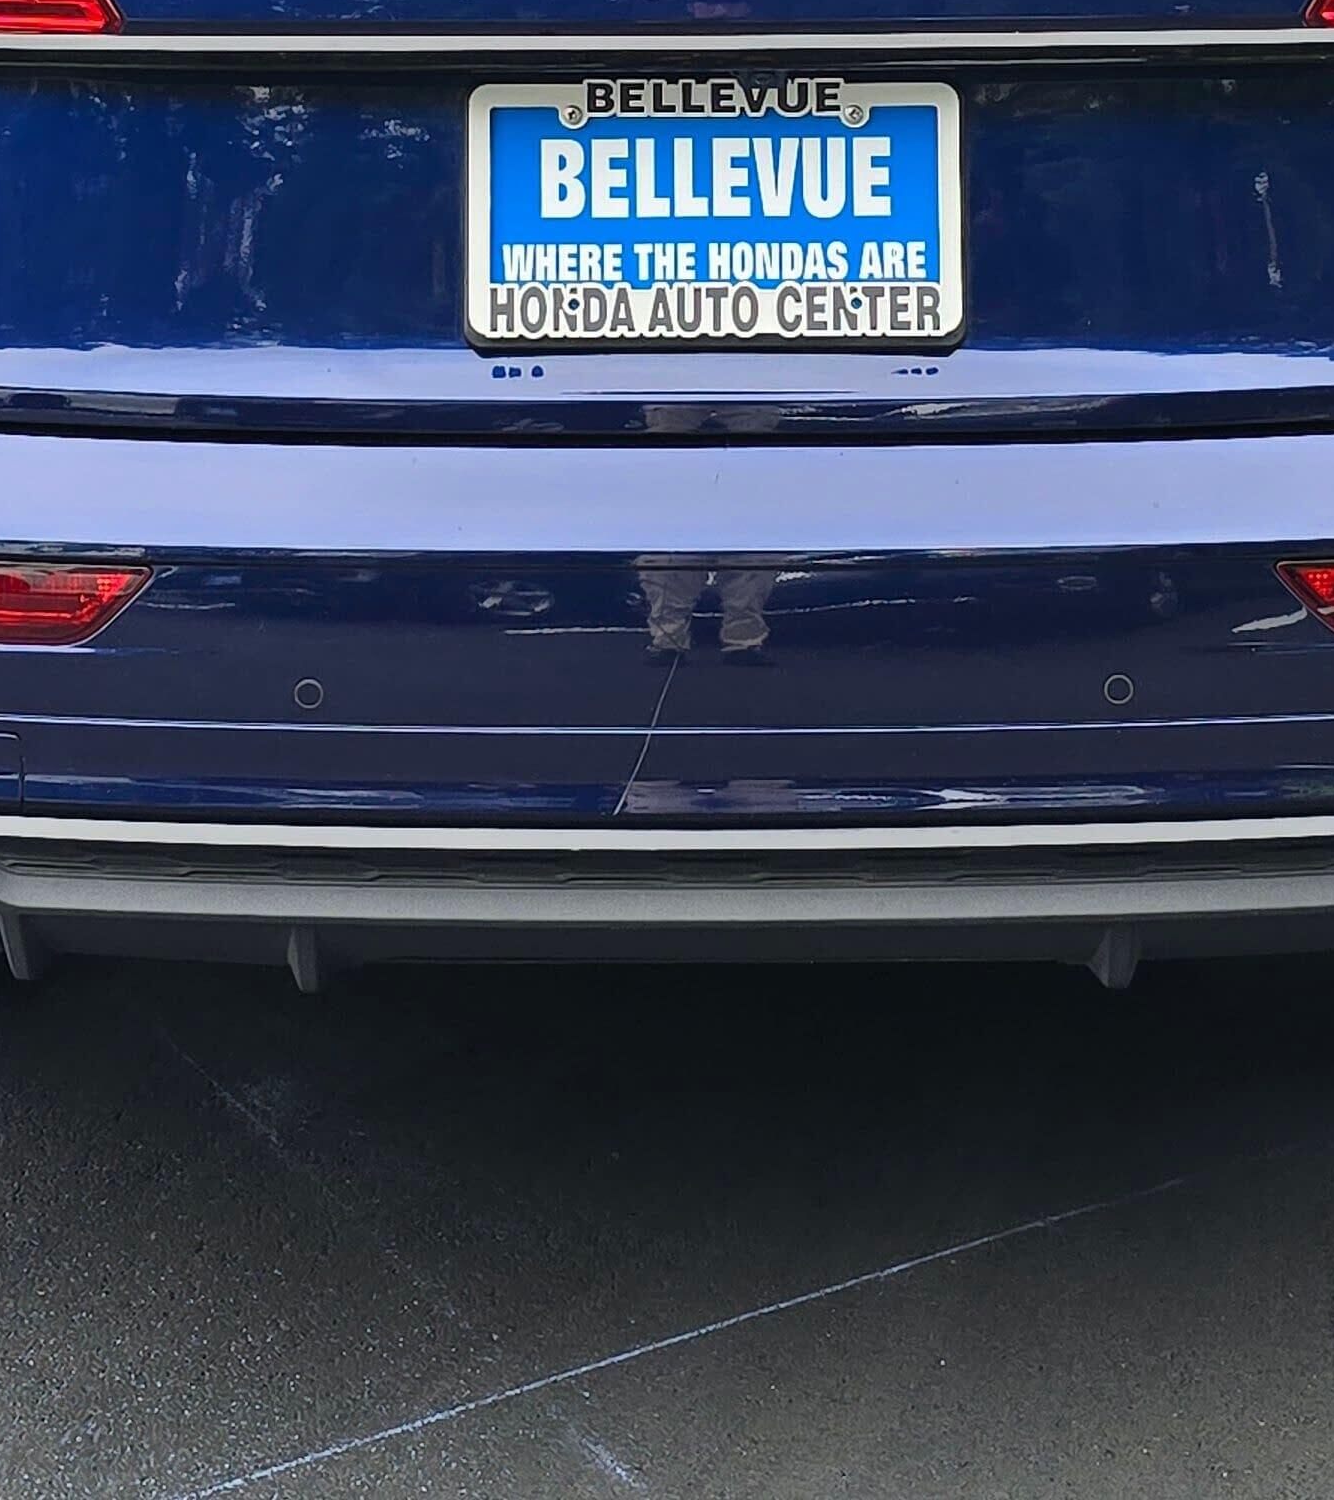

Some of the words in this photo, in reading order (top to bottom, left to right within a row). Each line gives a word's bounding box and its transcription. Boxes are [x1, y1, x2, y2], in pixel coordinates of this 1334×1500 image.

[587, 81, 842, 114] BELLEVUE
[540, 137, 892, 218] BELLEVUE
[502, 243, 623, 282] WHERE
[634, 243, 696, 280] THE
[709, 241, 849, 280] HONDAS
[860, 241, 927, 279] ARE
[489, 287, 636, 332] HONDA
[648, 286, 760, 332] AUTO
[776, 286, 941, 331] CENTER
